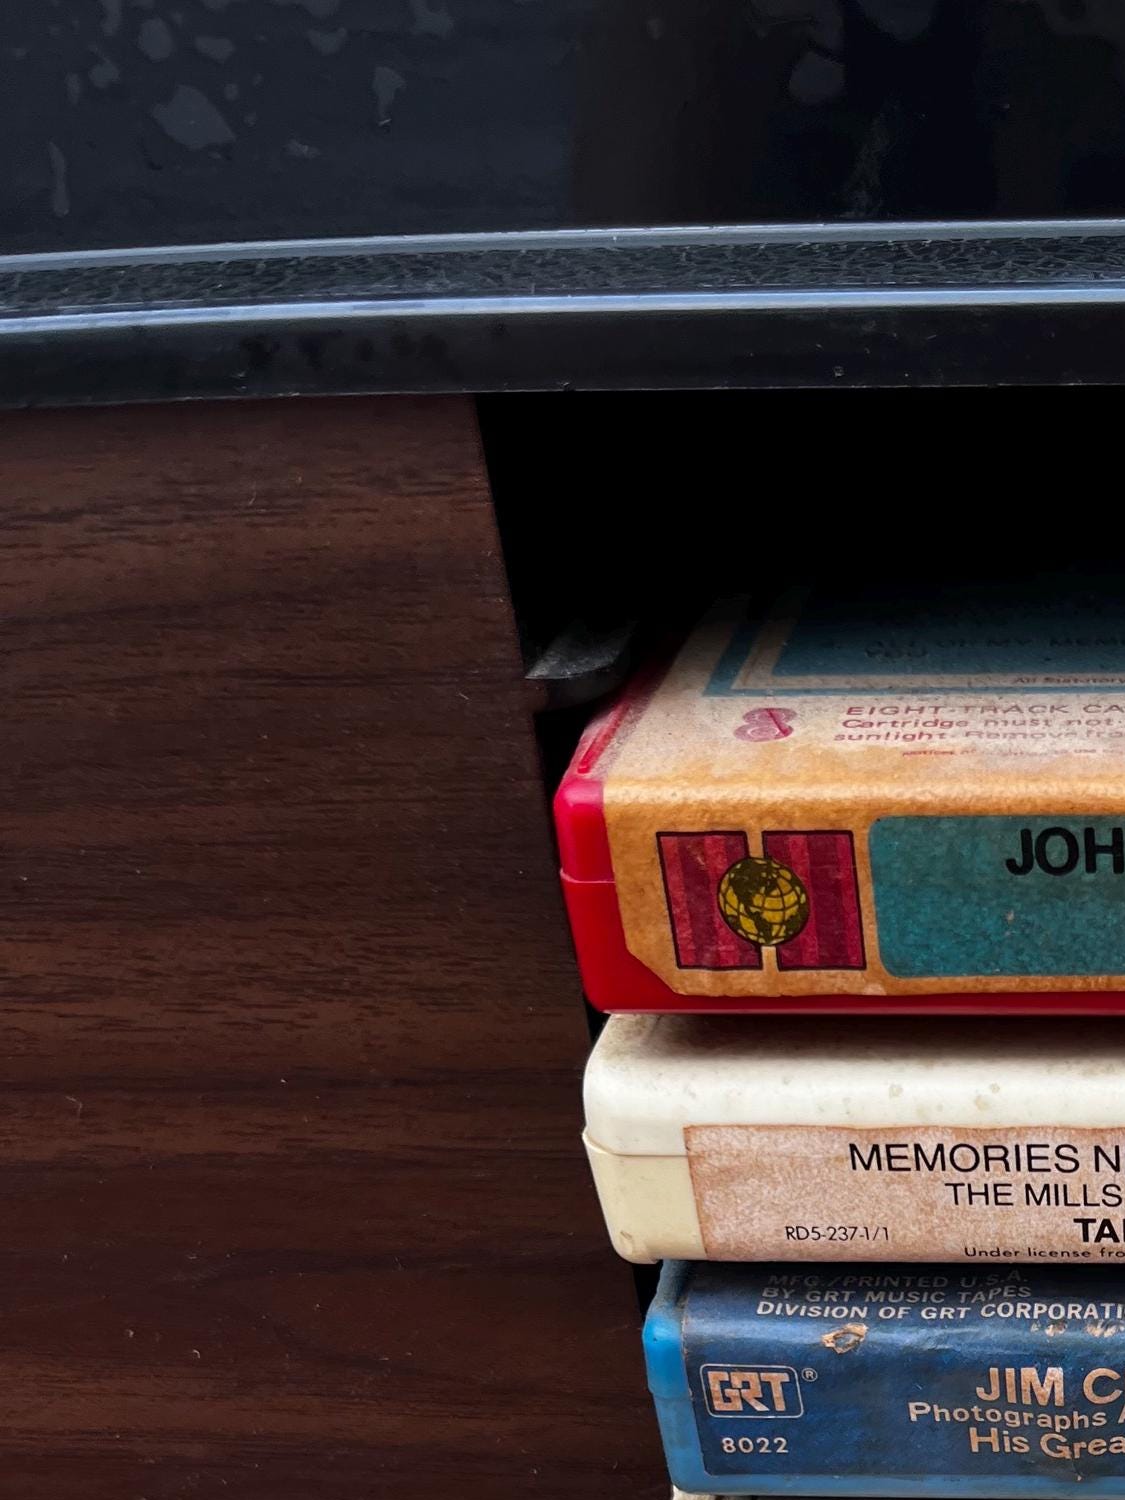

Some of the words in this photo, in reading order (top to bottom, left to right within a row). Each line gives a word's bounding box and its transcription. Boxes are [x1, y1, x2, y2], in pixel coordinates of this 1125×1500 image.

[845, 704, 1070, 717] EIGHT-TRACK
[841, 718, 969, 730] Cartridge
[983, 717, 1053, 728] must
[1065, 716, 1114, 727] not
[963, 729, 1078, 740] Remove
[848, 1143, 1080, 1174] MEMORIES
[944, 1182, 1014, 1207] THE
[1024, 1183, 1123, 1208] MILLS
[784, 1225, 891, 1242] RD5-237-1/1
[964, 1246, 1021, 1259] Under
[1027, 1246, 1092, 1259] license
[767, 1274, 949, 1289] MFG./PRINTED
[960, 1267, 1031, 1289] U.S.A.
[761, 1287, 794, 1299] BY
[805, 1290, 856, 1303] GRT
[864, 1291, 946, 1304] MUSIC
[957, 1284, 1033, 1304] TAPES
[755, 1300, 869, 1319] DIVISION
[877, 1305, 912, 1319] OF
[920, 1305, 972, 1320] GRT
[707, 1370, 791, 1413] GRT
[975, 1366, 1065, 1407] JIM
[907, 1401, 1107, 1430] Photographs
[721, 1436, 789, 1454] 8022
[969, 1427, 1031, 1454] His
